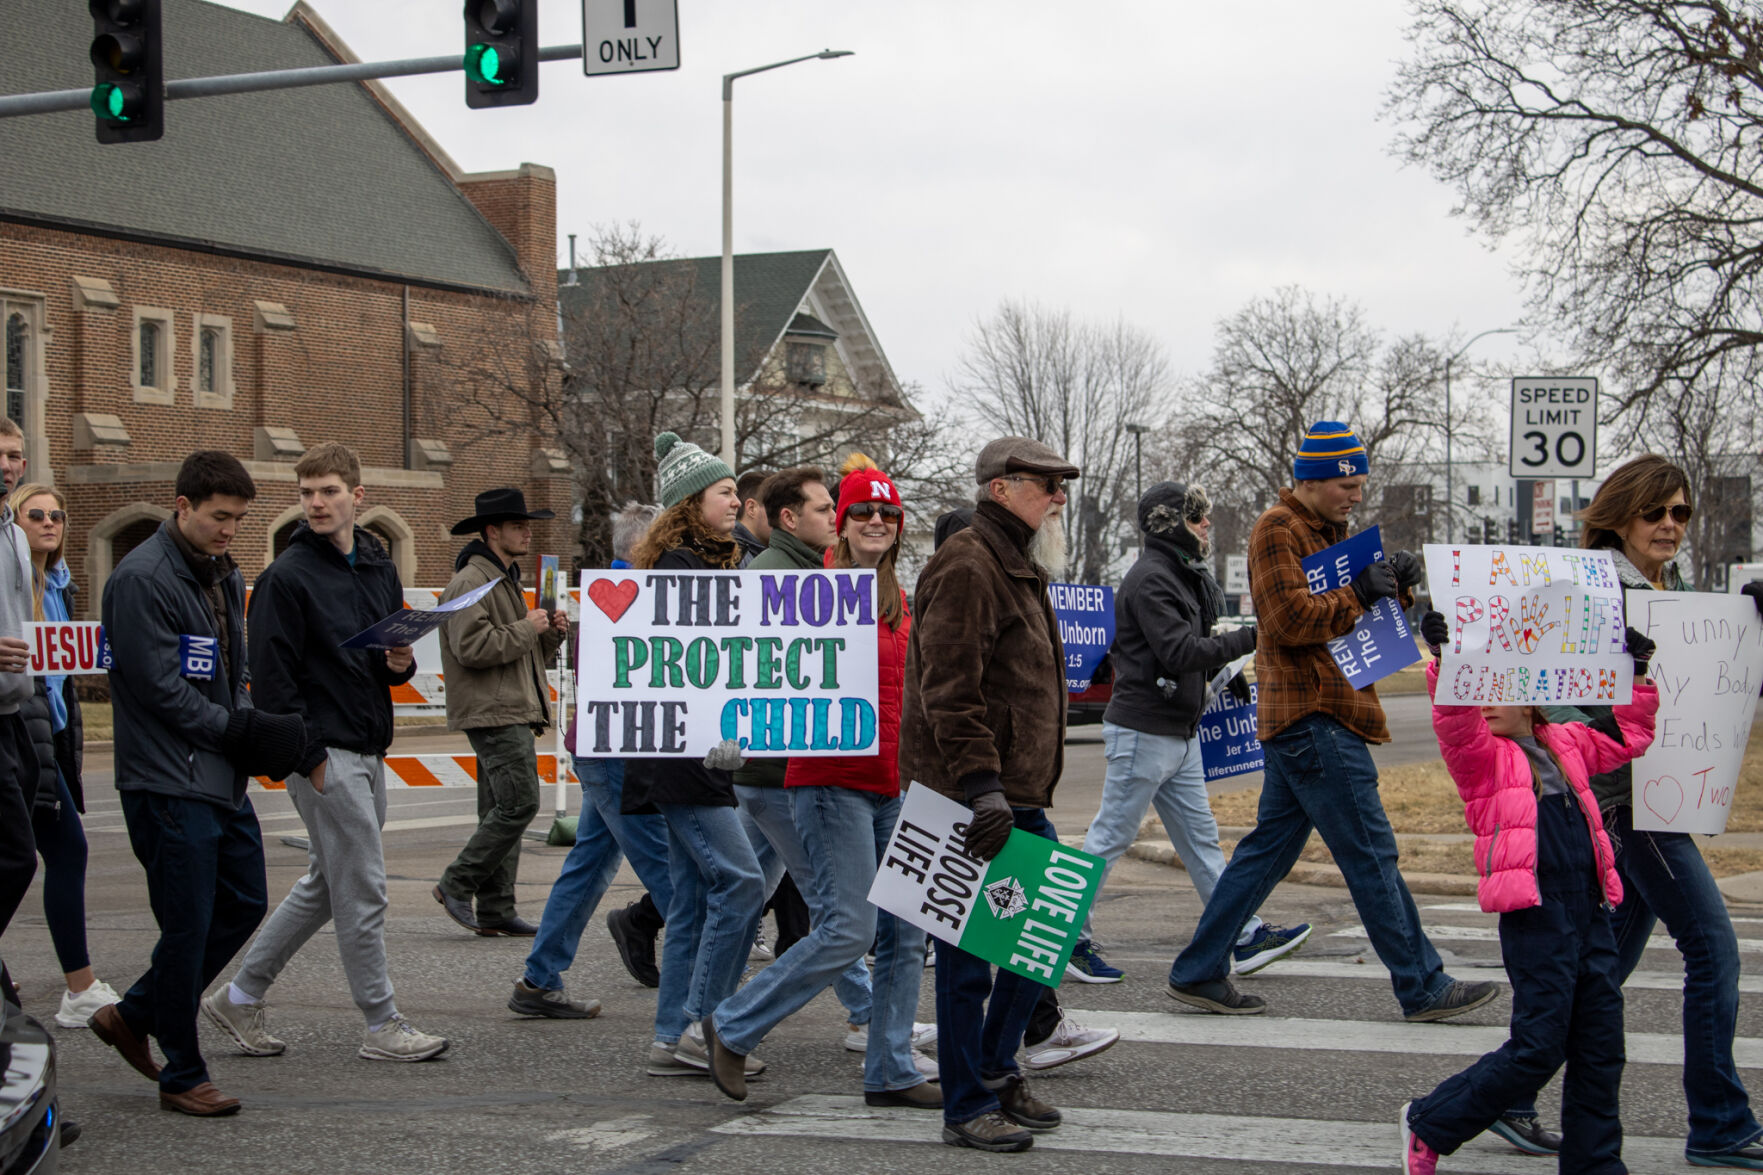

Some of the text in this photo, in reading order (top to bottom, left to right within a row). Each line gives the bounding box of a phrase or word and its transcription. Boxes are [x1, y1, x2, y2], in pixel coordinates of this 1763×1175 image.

[599, 36, 662, 63] ONLY
[1520, 387, 1590, 403] SPEED
[1526, 409, 1581, 425] LIMIT
[1521, 431, 1585, 467] 30
[870, 480, 891, 500] N
[1452, 550, 1614, 588] I AM THE
[646, 573, 875, 627] THE MOM
[1059, 619, 1106, 646] Unborn
[1646, 598, 1748, 660] Funny
[612, 635, 845, 690] PROTECT
[1356, 629, 1382, 668] The
[1454, 664, 1616, 702] GENERATION
[587, 697, 876, 753] THE CHILD
[1661, 719, 1722, 752] Ends
[1226, 739, 1262, 757] Jer 1:5
[1692, 766, 1730, 810] Two
[886, 819, 941, 885] LIFE
[1009, 849, 1094, 979] LOVE LIFE
